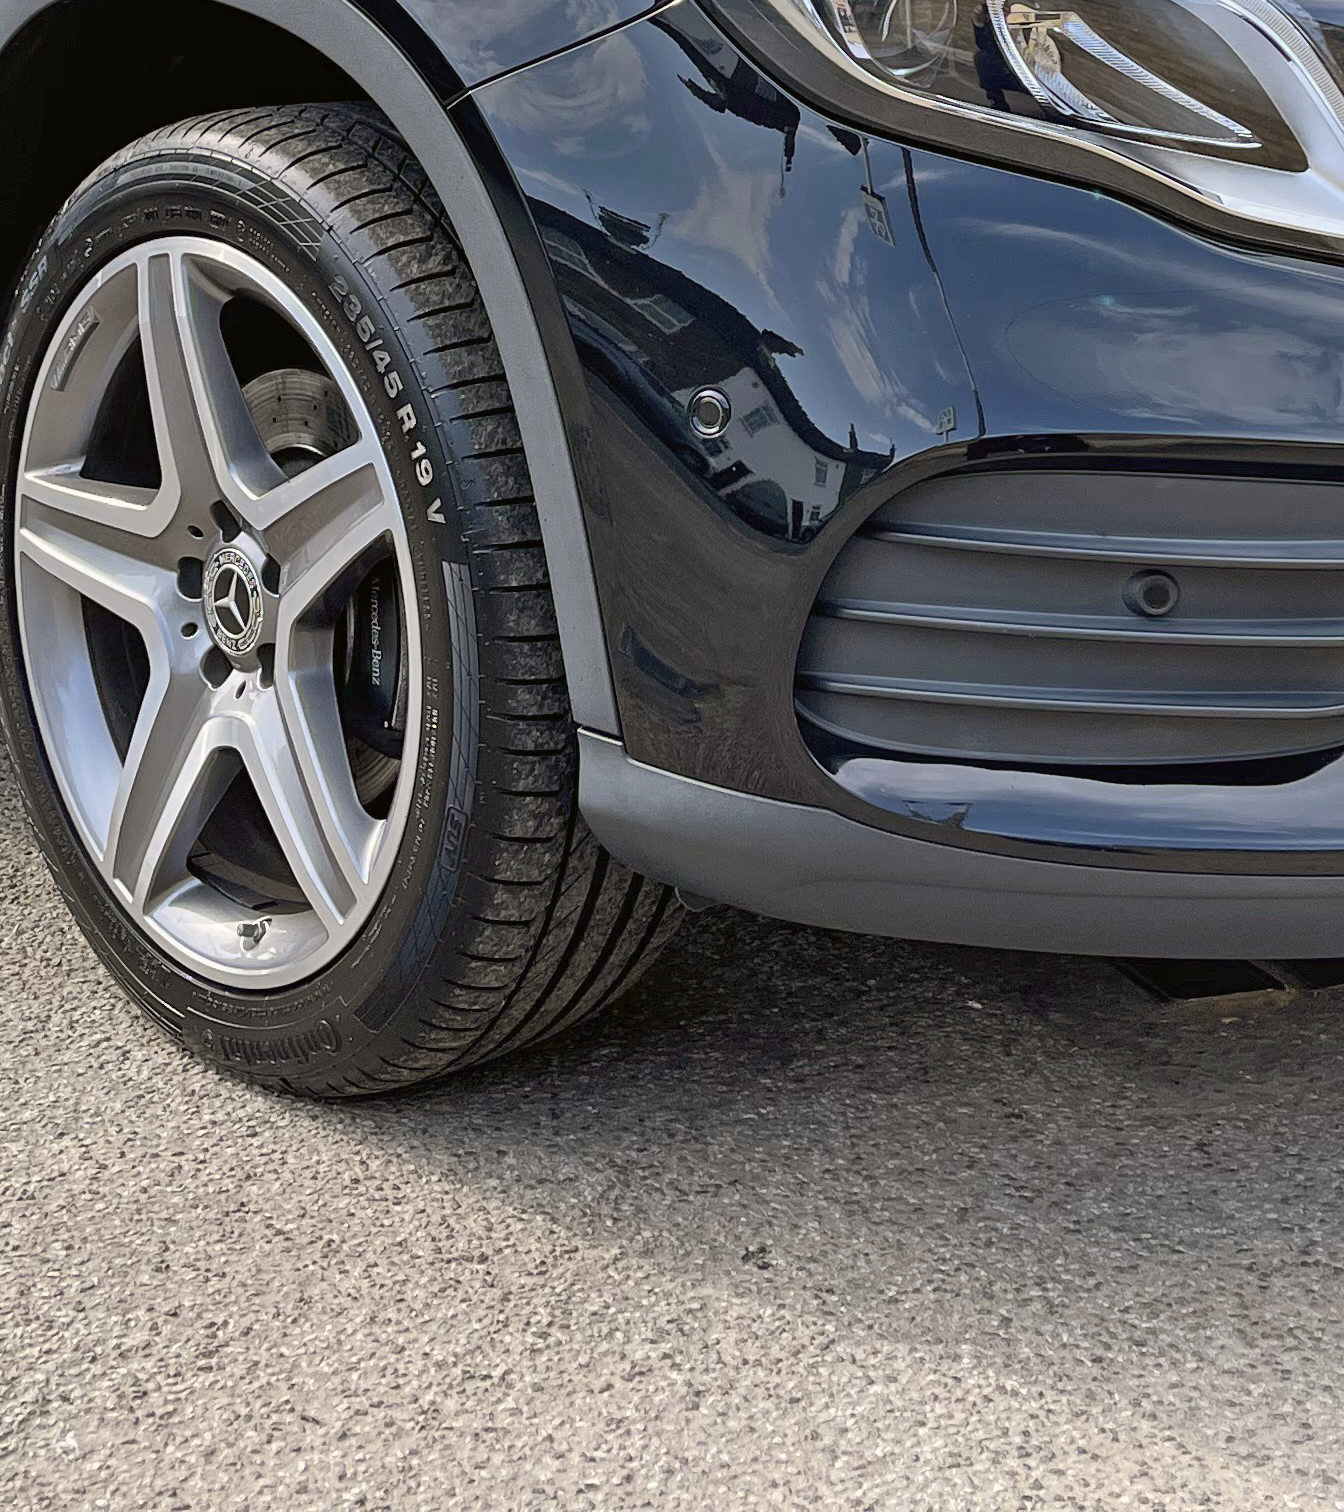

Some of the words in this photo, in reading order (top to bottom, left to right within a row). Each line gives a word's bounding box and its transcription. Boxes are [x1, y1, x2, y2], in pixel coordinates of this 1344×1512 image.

[394, 402, 418, 437] R
[409, 440, 435, 488] 19
[425, 496, 448, 525] V
